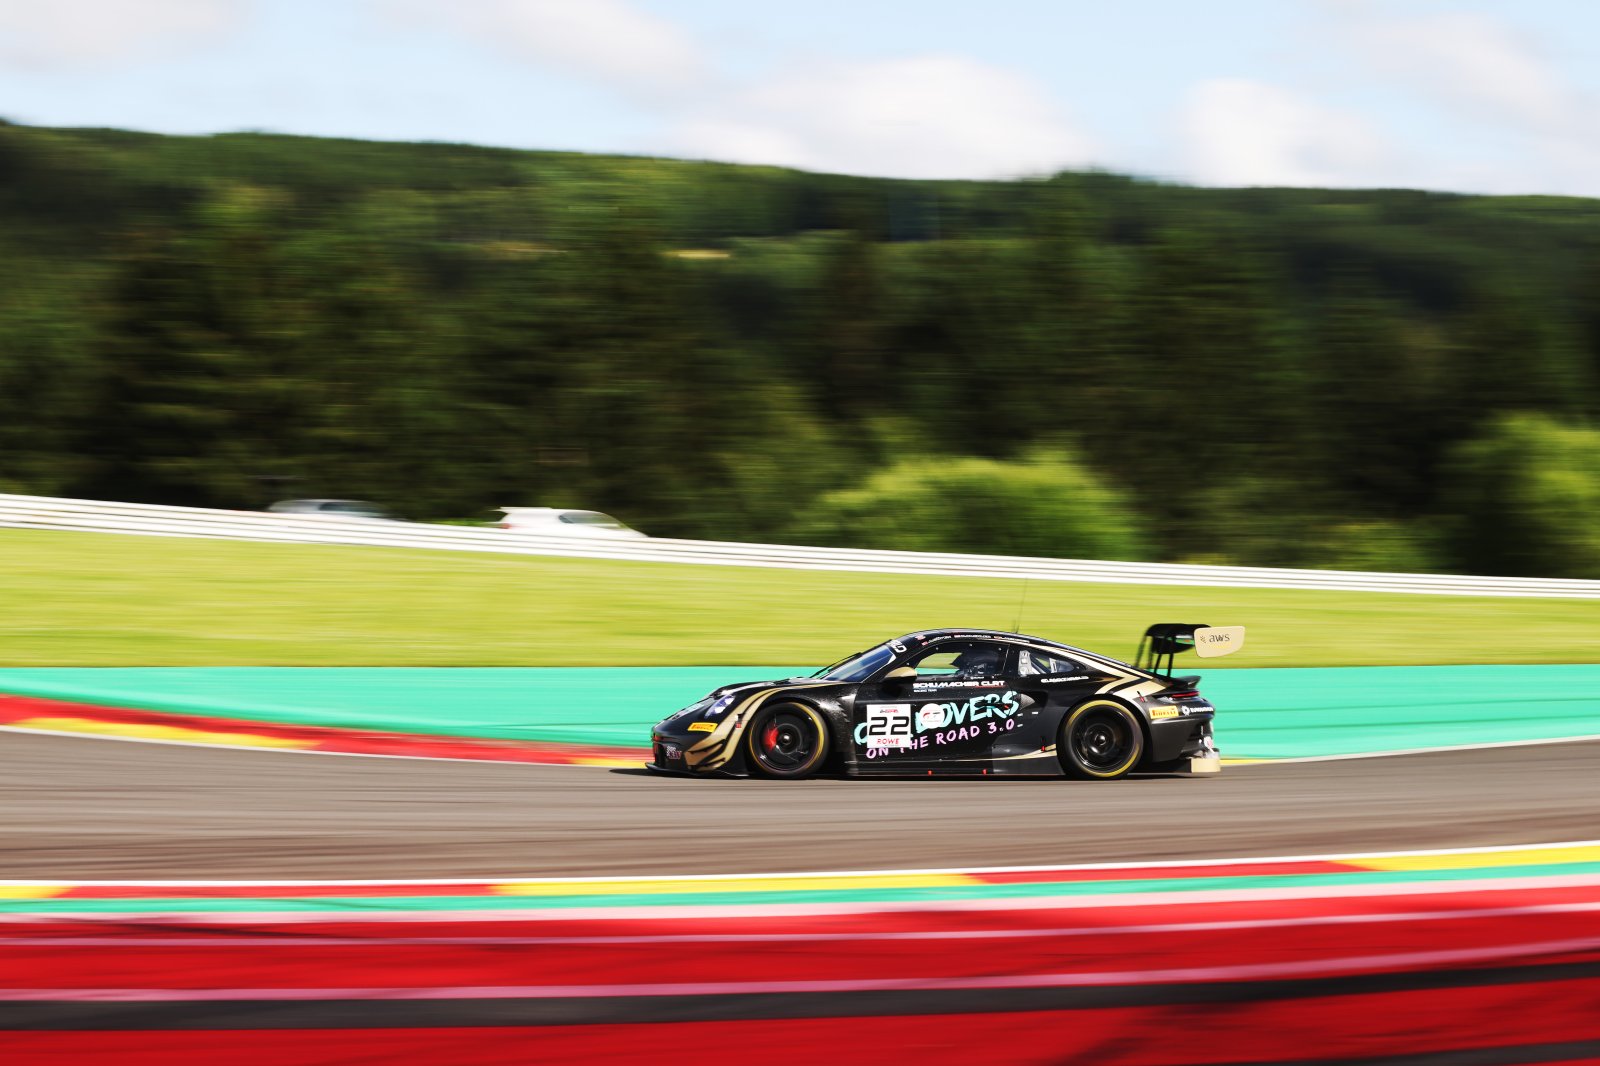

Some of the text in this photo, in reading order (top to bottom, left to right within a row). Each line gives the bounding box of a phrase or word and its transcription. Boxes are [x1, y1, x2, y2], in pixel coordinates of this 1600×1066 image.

[1208, 633, 1231, 643] aws
[912, 681, 980, 689] SCHUMACHER
[868, 716, 909, 736] 22
[866, 747, 889, 759] ON
[936, 726, 980, 745] ROAD
[987, 719, 1015, 734] 3.0
